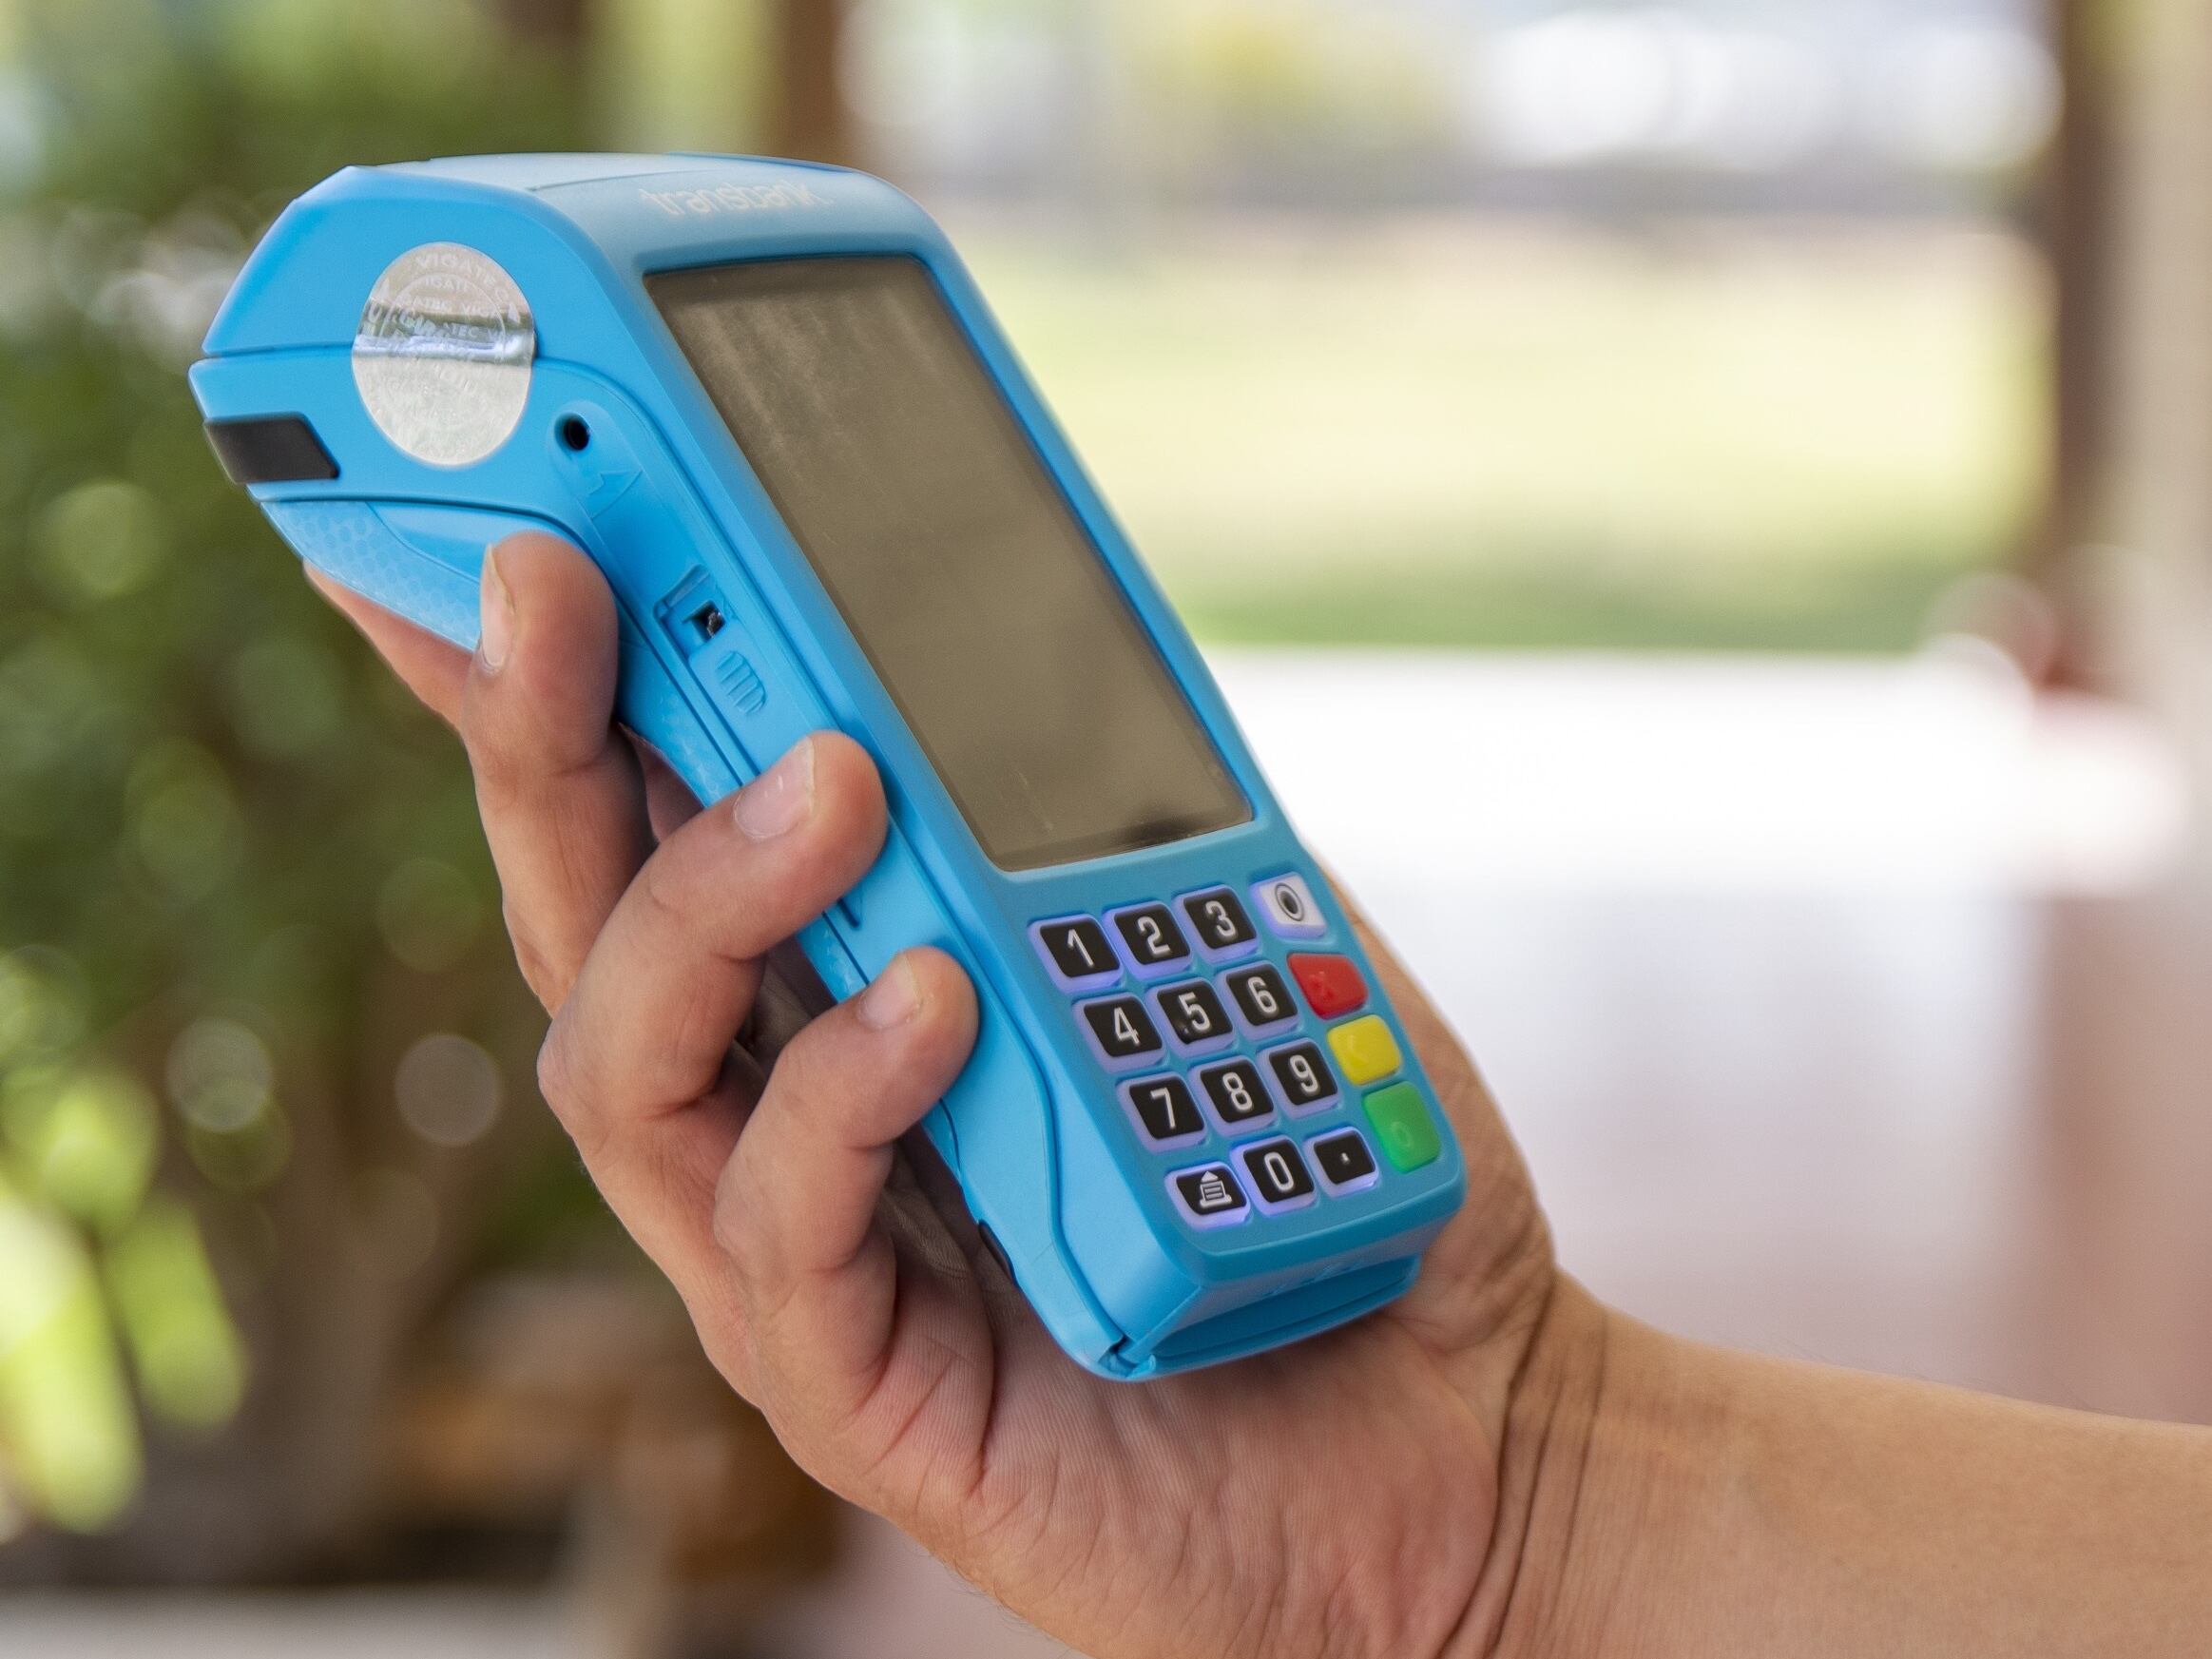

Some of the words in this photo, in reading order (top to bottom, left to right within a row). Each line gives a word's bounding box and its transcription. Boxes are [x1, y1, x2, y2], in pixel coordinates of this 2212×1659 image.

[1067, 928, 1094, 968] 1
[1139, 915, 1171, 955] 2
[1204, 899, 1237, 938] 3
[1113, 1006, 1141, 1046] 4
[1179, 992, 1211, 1032] 5
[1247, 975, 1278, 1014] 6
[1150, 1087, 1176, 1129] 7
[1221, 1071, 1254, 1112] 8
[1289, 1053, 1319, 1093] 9
[1263, 1150, 1295, 1192] 0
